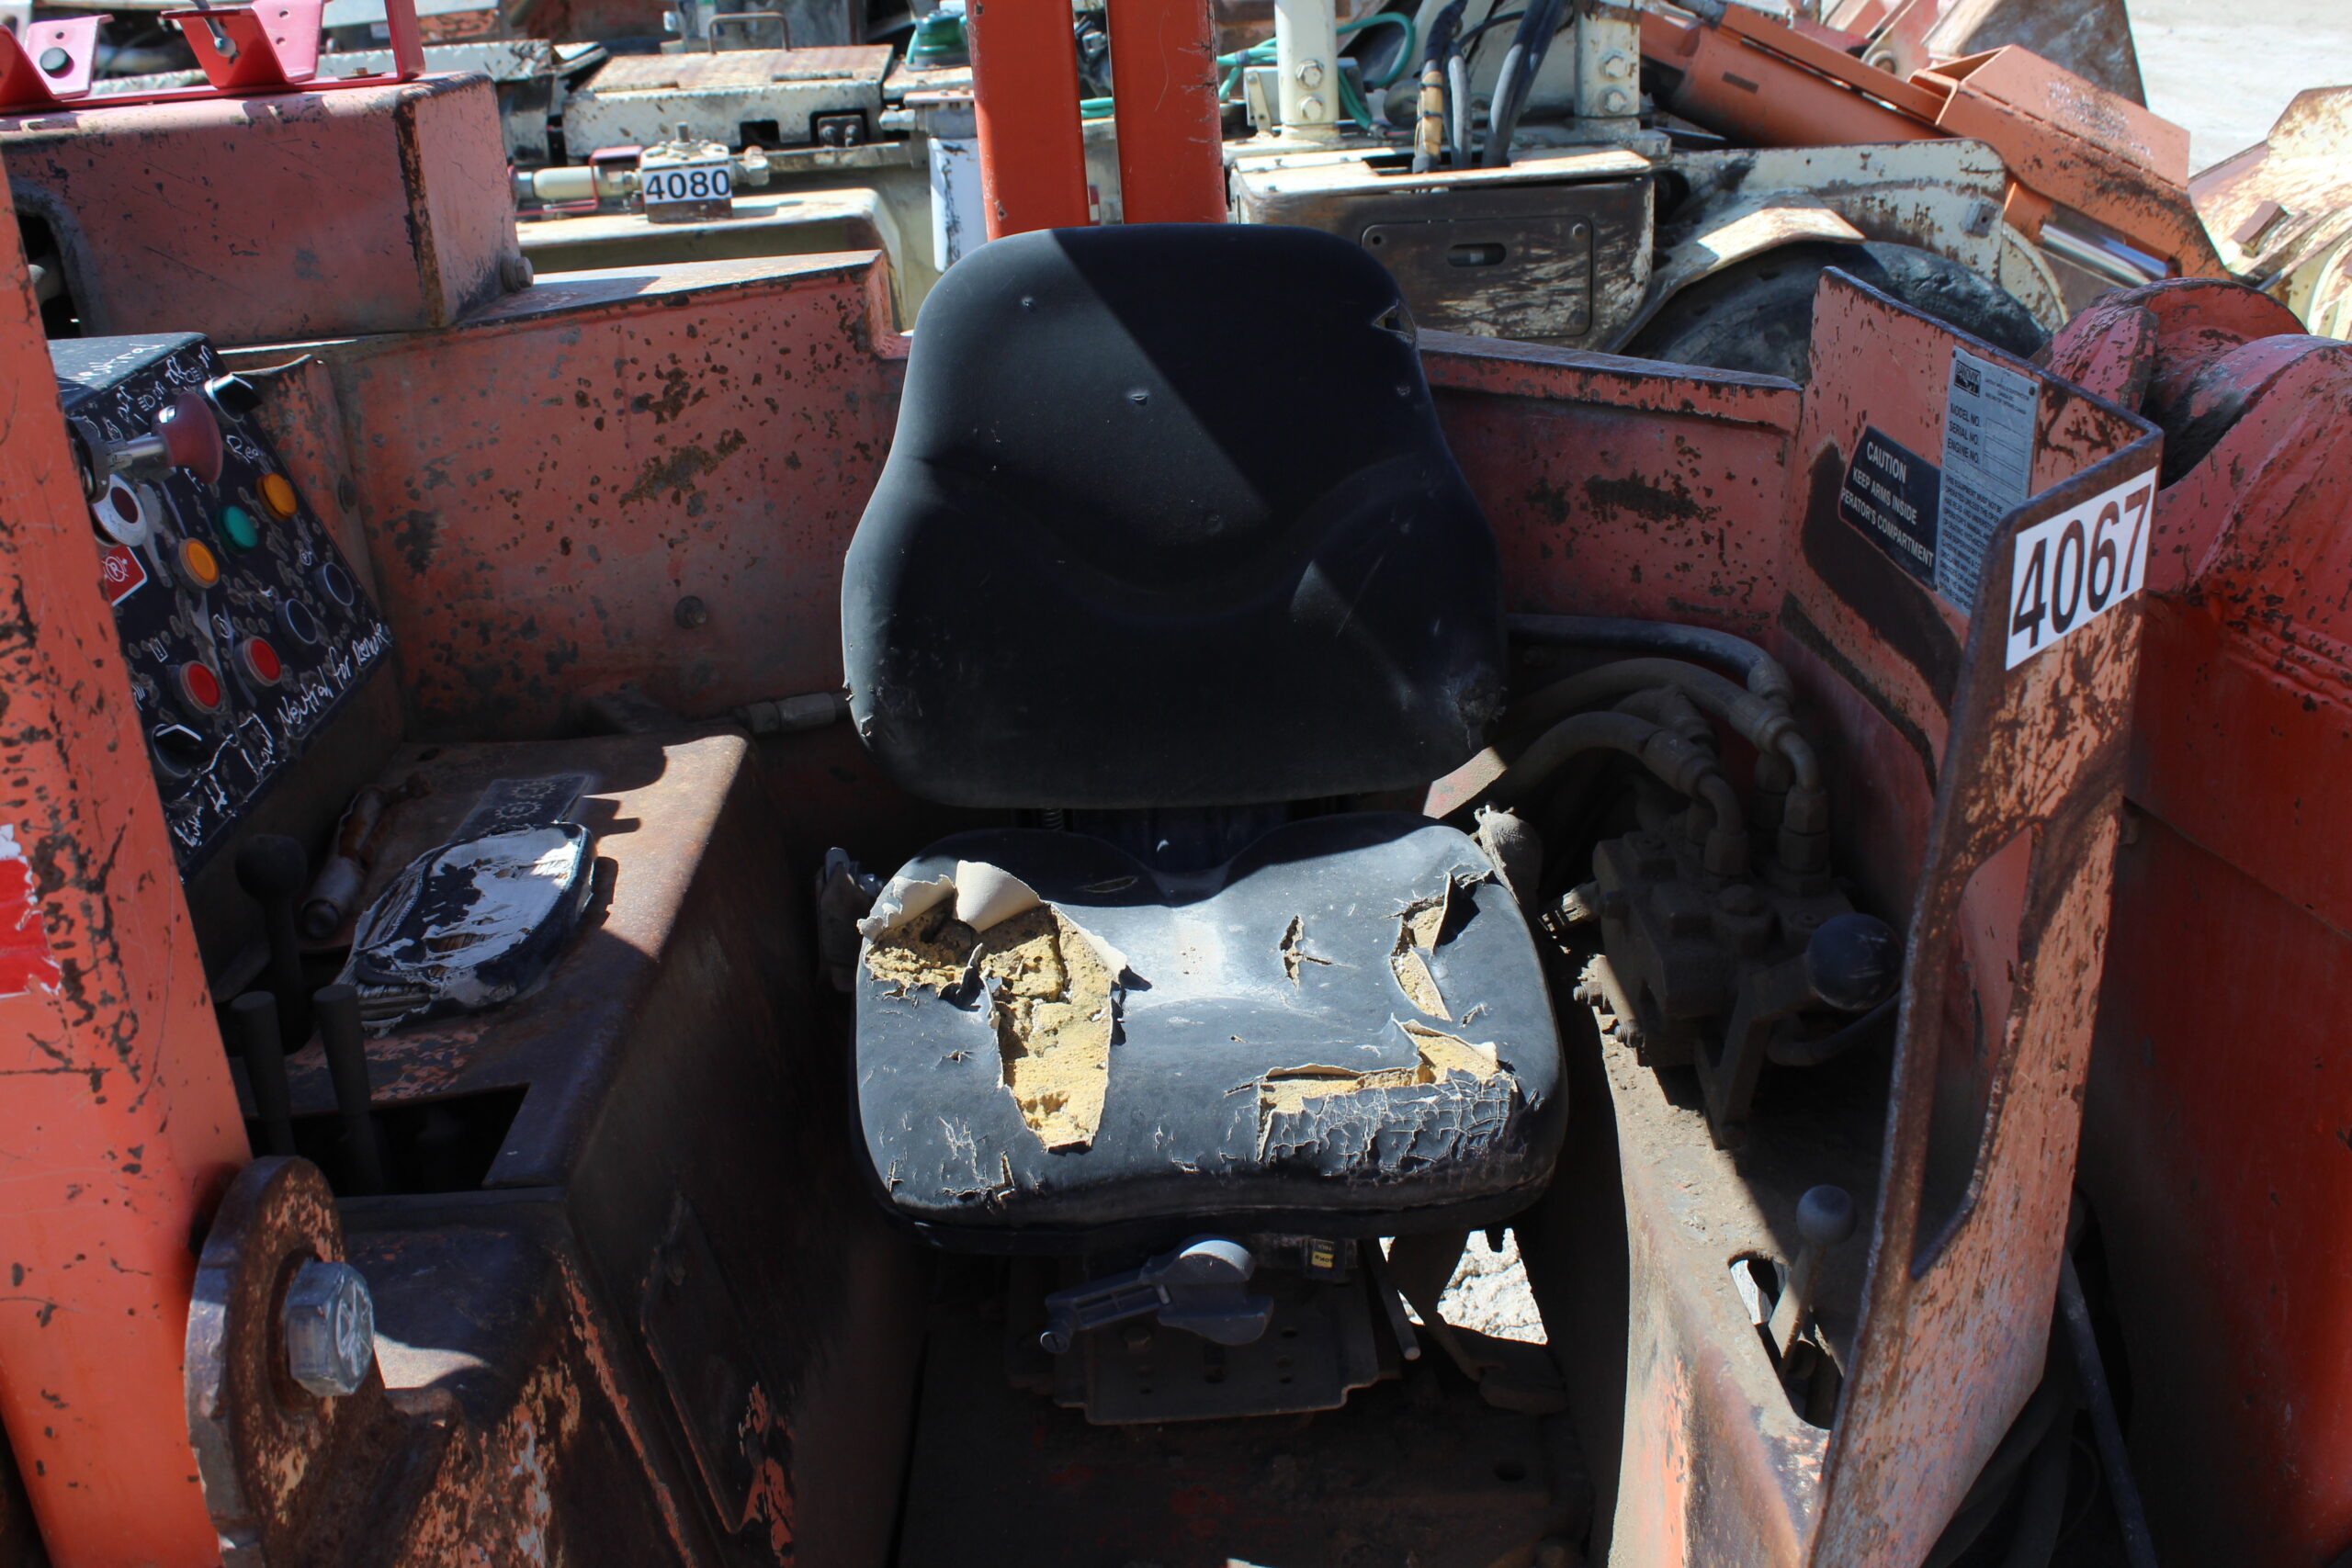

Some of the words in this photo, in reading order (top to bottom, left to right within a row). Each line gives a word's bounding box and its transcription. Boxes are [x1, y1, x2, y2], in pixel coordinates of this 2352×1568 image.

[646, 169, 730, 200] 4080
[1949, 421, 1969, 441] SERIAL
[1950, 403, 1970, 423] MODEL
[1867, 441, 1907, 484] CAUTION
[1947, 438, 1969, 459] ENGINE
[1852, 466, 1871, 491] KEEP
[1871, 479, 1892, 506] ARMS
[1892, 496, 1917, 525] INSIDE
[1840, 487, 1877, 525] PERATOR'S
[1877, 513, 1934, 568] COMPARTMENT
[2011, 482, 2153, 649] 4067
